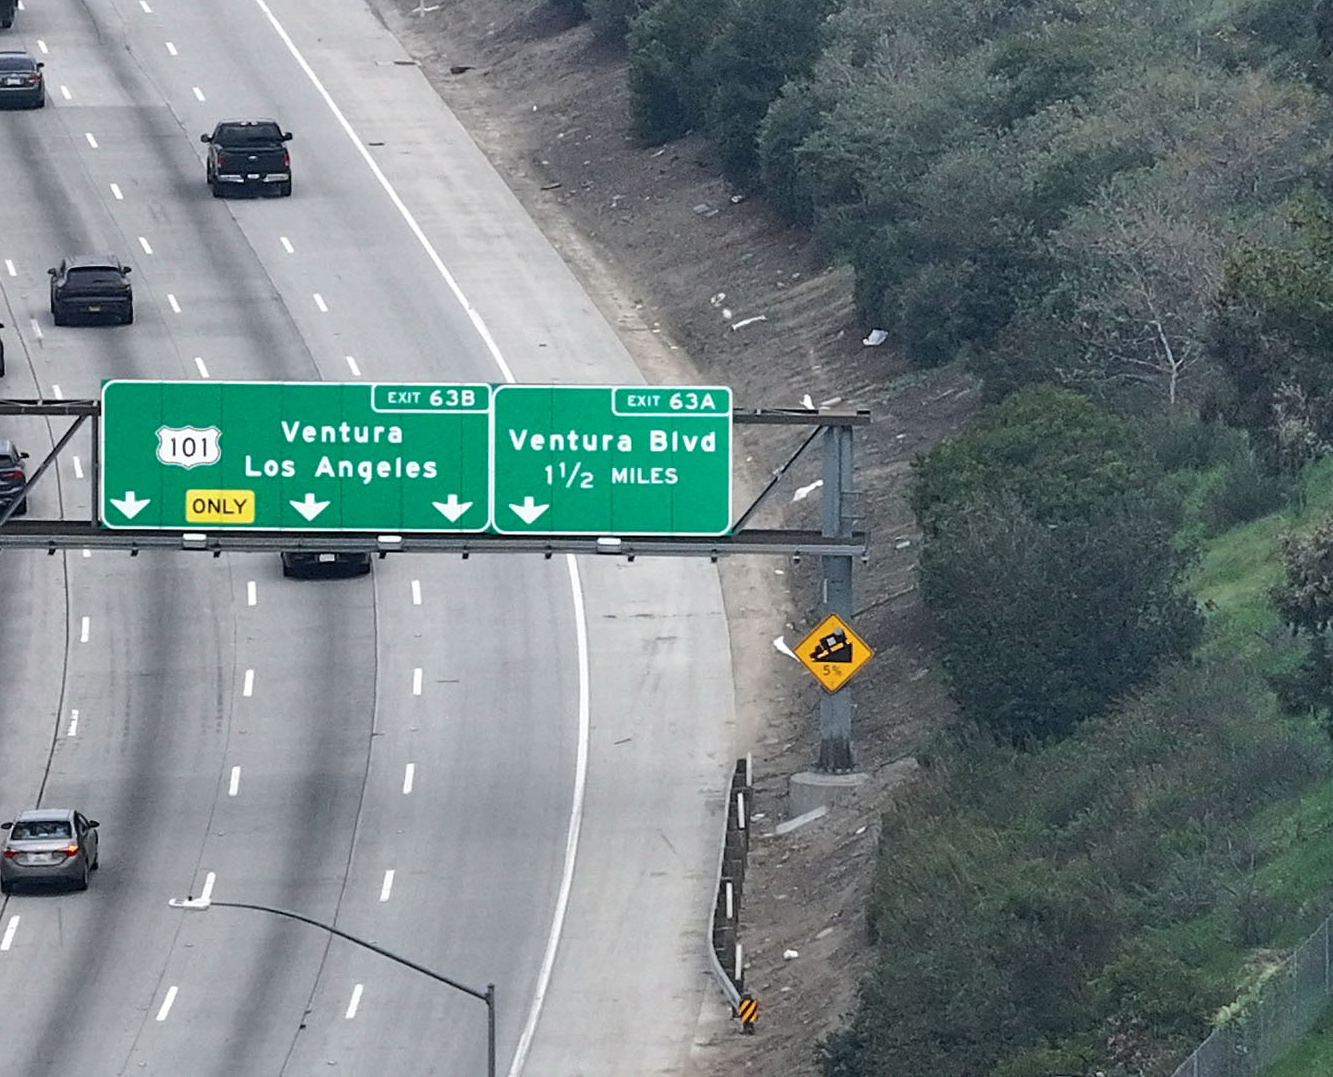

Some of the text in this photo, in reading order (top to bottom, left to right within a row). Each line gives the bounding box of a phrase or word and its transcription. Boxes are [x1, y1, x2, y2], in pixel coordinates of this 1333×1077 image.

[387, 390, 476, 406] EXIT 63B
[627, 393, 716, 409] EXIT 63A
[281, 421, 403, 443] Ventura
[509, 428, 716, 452] Ventura Blvd
[169, 437, 209, 457] 101
[244, 455, 438, 484] Los Angeles
[611, 467, 679, 484] MILES
[192, 498, 248, 514] ONLY
[822, 664, 842, 676] 5%
